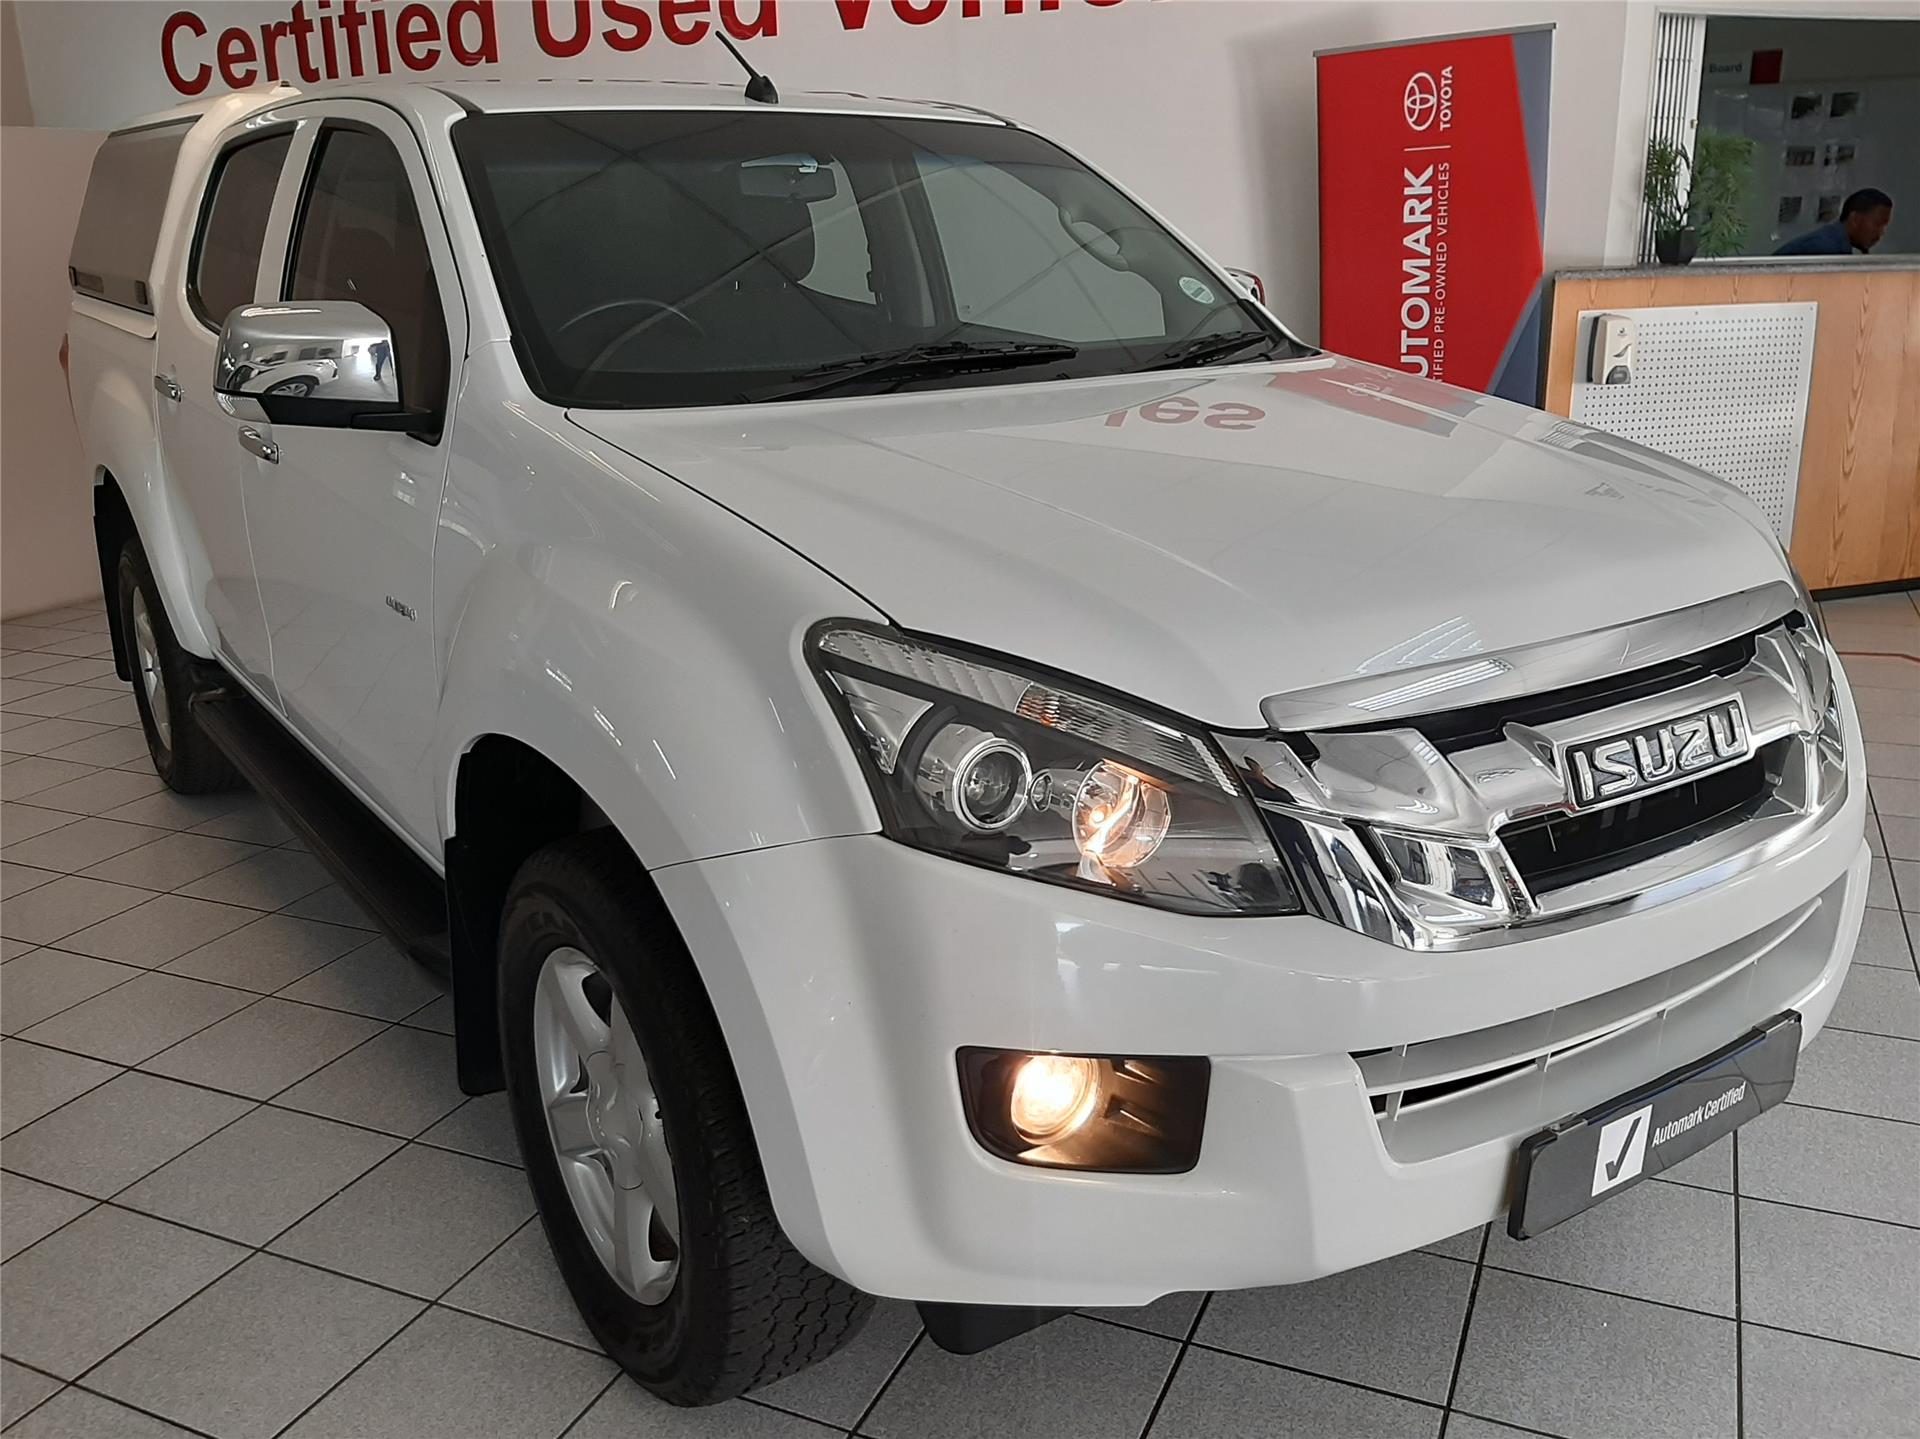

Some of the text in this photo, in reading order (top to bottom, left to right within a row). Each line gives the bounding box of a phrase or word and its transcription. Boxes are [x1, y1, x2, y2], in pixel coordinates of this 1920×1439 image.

[161, 0, 498, 95] Certified
[1439, 66, 1453, 132] TOYOTA
[1436, 162, 1450, 237] VEHICLES
[1400, 164, 1435, 378] UTOMARK
[1433, 241, 1448, 333] PRE-OWNED
[1573, 705, 1748, 801] ISUZU
[1652, 1081, 1747, 1148] Automark Certified
